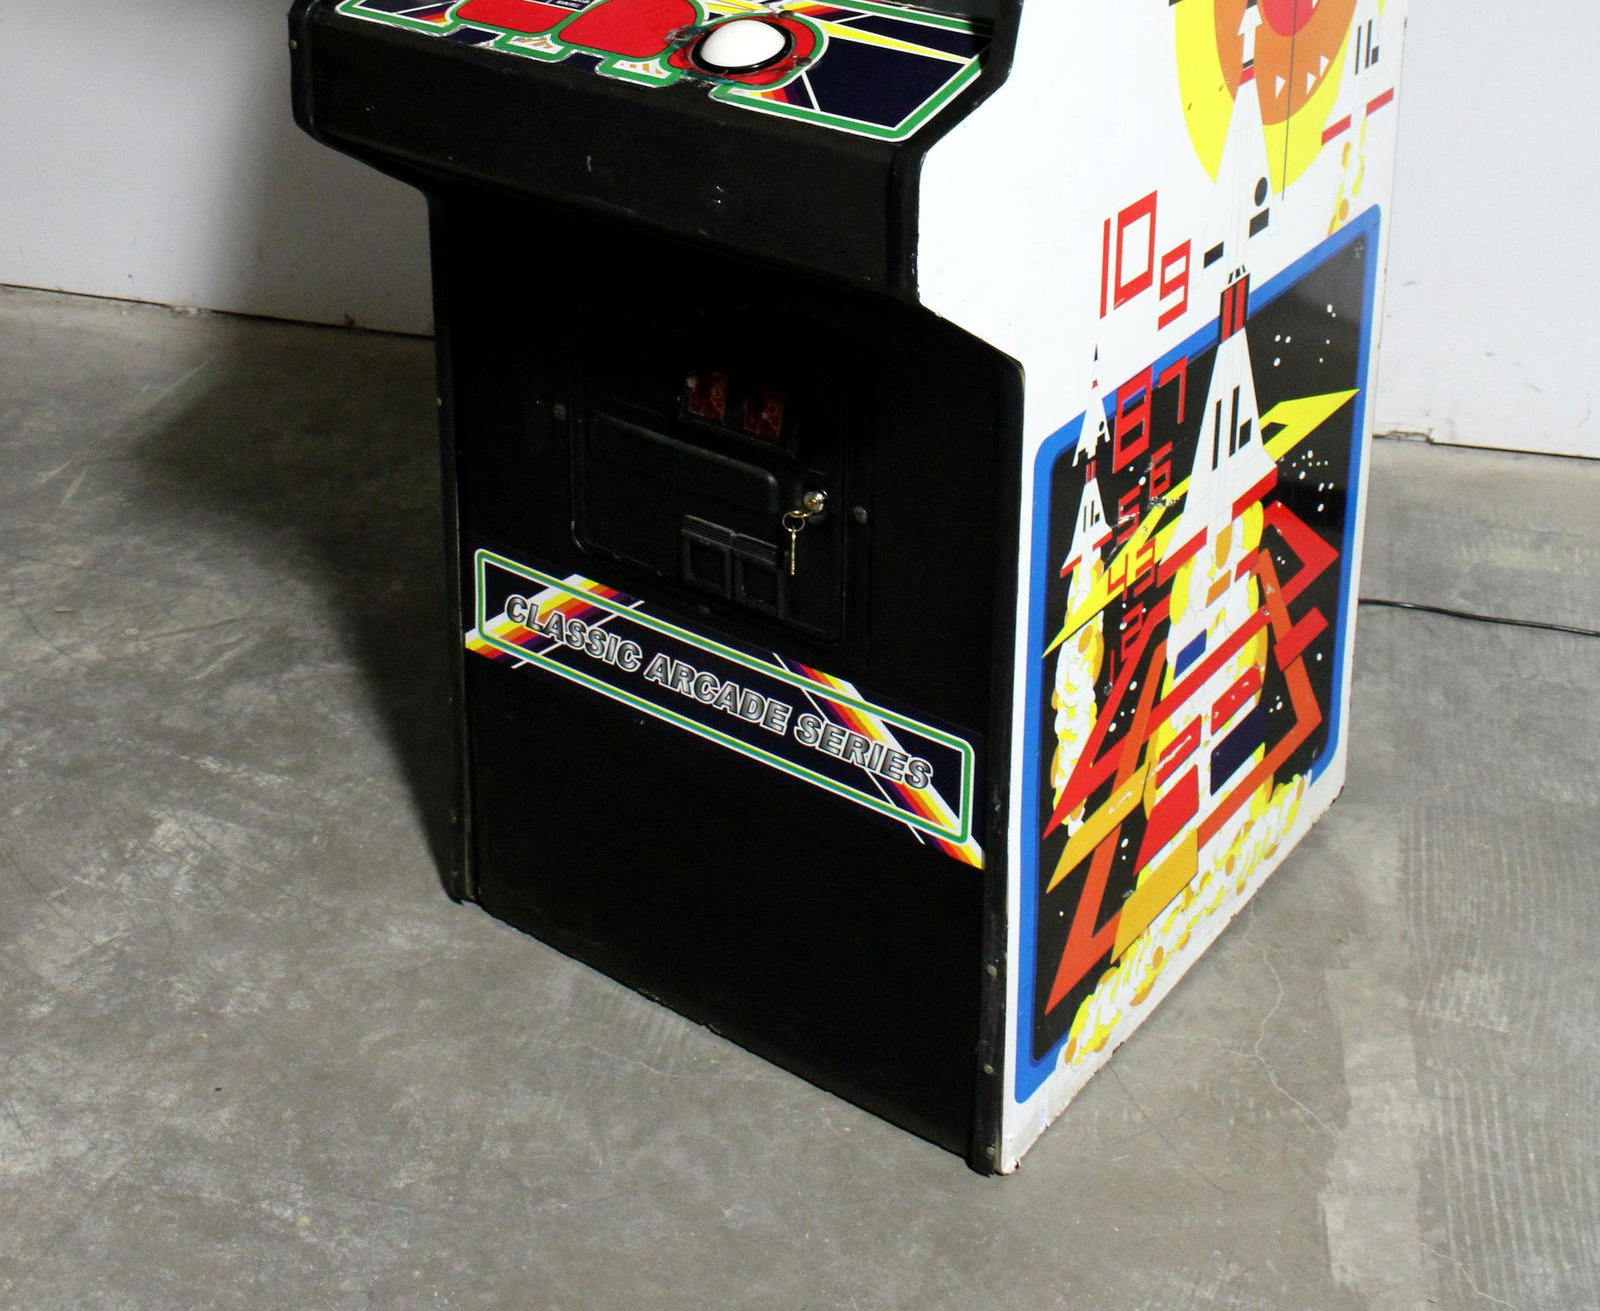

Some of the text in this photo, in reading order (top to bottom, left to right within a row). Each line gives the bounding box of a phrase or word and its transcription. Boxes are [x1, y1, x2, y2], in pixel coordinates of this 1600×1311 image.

[1100, 189, 1158, 320] 10
[1157, 238, 1192, 331] 9
[1112, 364, 1153, 474] 8
[1157, 355, 1188, 425] 7
[1116, 485, 1141, 546] 5
[1150, 440, 1173, 501] 6
[505, 594, 934, 790] CLASSIC ARCADE SERIES
